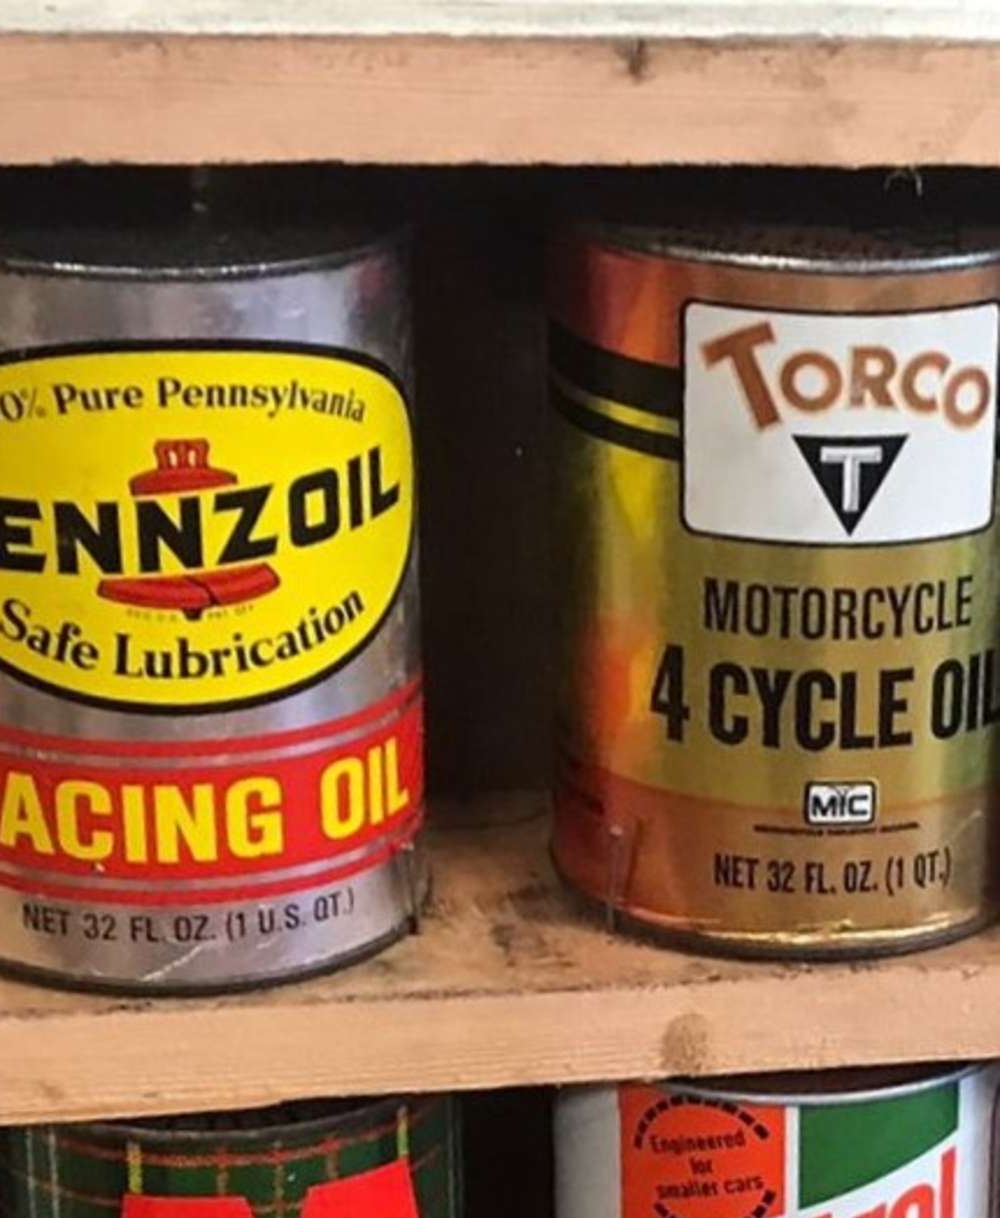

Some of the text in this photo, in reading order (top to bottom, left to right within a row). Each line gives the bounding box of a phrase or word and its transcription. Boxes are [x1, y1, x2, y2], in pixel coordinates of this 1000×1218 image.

[53, 382, 143, 416] Pure
[158, 377, 366, 424] Pennsylvania
[701, 320, 991, 431] TORCO
[820, 446, 882, 514] T
[114, 590, 366, 681] Lubrication
[703, 575, 975, 641] MOTORCYCLE
[649, 644, 1000, 752] 4 CYCLE OIL
[320, 737, 410, 841] OIL
[811, 793, 869, 818] MIC
[714, 845, 951, 897] NET 32 FL. OZ. (1 QT.)
[23, 902, 70, 937] NET
[83, 911, 117, 941] 32
[174, 914, 217, 940] OZ.
[226, 909, 247, 939] (1
[258, 903, 307, 936] U.S.
[313, 885, 356, 925] QT.)
[648, 1126, 746, 1156] Engineered
[689, 1155, 714, 1176] for
[656, 1173, 765, 1202] smaller cars
